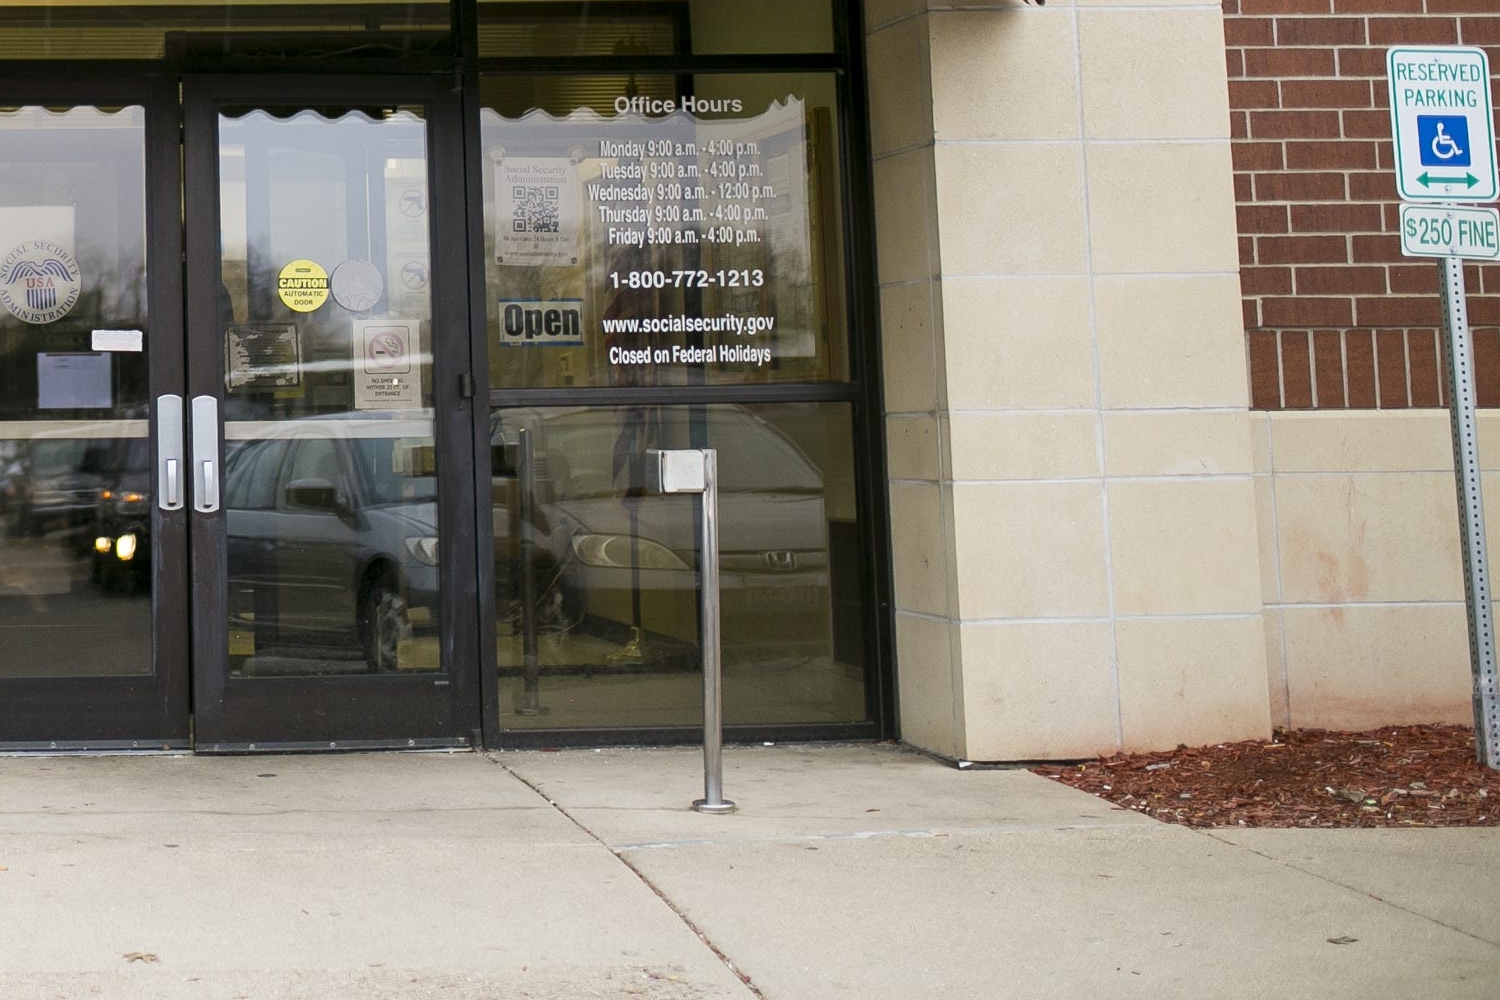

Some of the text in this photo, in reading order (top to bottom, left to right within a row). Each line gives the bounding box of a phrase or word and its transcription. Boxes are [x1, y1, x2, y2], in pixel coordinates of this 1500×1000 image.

[1396, 62, 1481, 82] RESERVED
[614, 96, 743, 114] Office Hours
[1404, 88, 1477, 108] PARKING
[600, 140, 645, 160] Monday
[647, 140, 672, 156] 9:00
[675, 143, 699, 156] a.m.
[736, 141, 760, 158] p.m.
[504, 165, 566, 175] Social Security
[505, 174, 567, 184] Administration
[600, 163, 647, 182] Tuesday
[650, 162, 674, 178] 9:00
[678, 165, 701, 178] a.m.
[738, 163, 763, 181] p.m.
[588, 183, 653, 204] Wednesday
[657, 183, 681, 200] 9:00
[684, 186, 708, 199] a.m.
[752, 185, 777, 202] p.m.
[599, 205, 651, 226] Thursday
[655, 205, 679, 222] 9:00
[682, 208, 707, 221] a.m.
[744, 206, 768, 224] p.m.
[609, 227, 645, 248] Friday
[647, 227, 672, 243] 9:00
[674, 230, 699, 244] a.m.
[735, 228, 761, 246] p.m.
[1406, 218, 1496, 248] $250 FINE
[0, 242, 79, 278] SOCIAL SECURITY
[26, 277, 54, 289] USA
[279, 278, 327, 289] CAUTION
[609, 269, 764, 289] 1-800-772-1213
[0, 288, 79, 322] ADMINISTRATION
[504, 304, 579, 340] Open
[603, 313, 774, 335] www.socialsecurity.gov
[609, 344, 771, 366] Closed on Federal Holidays
